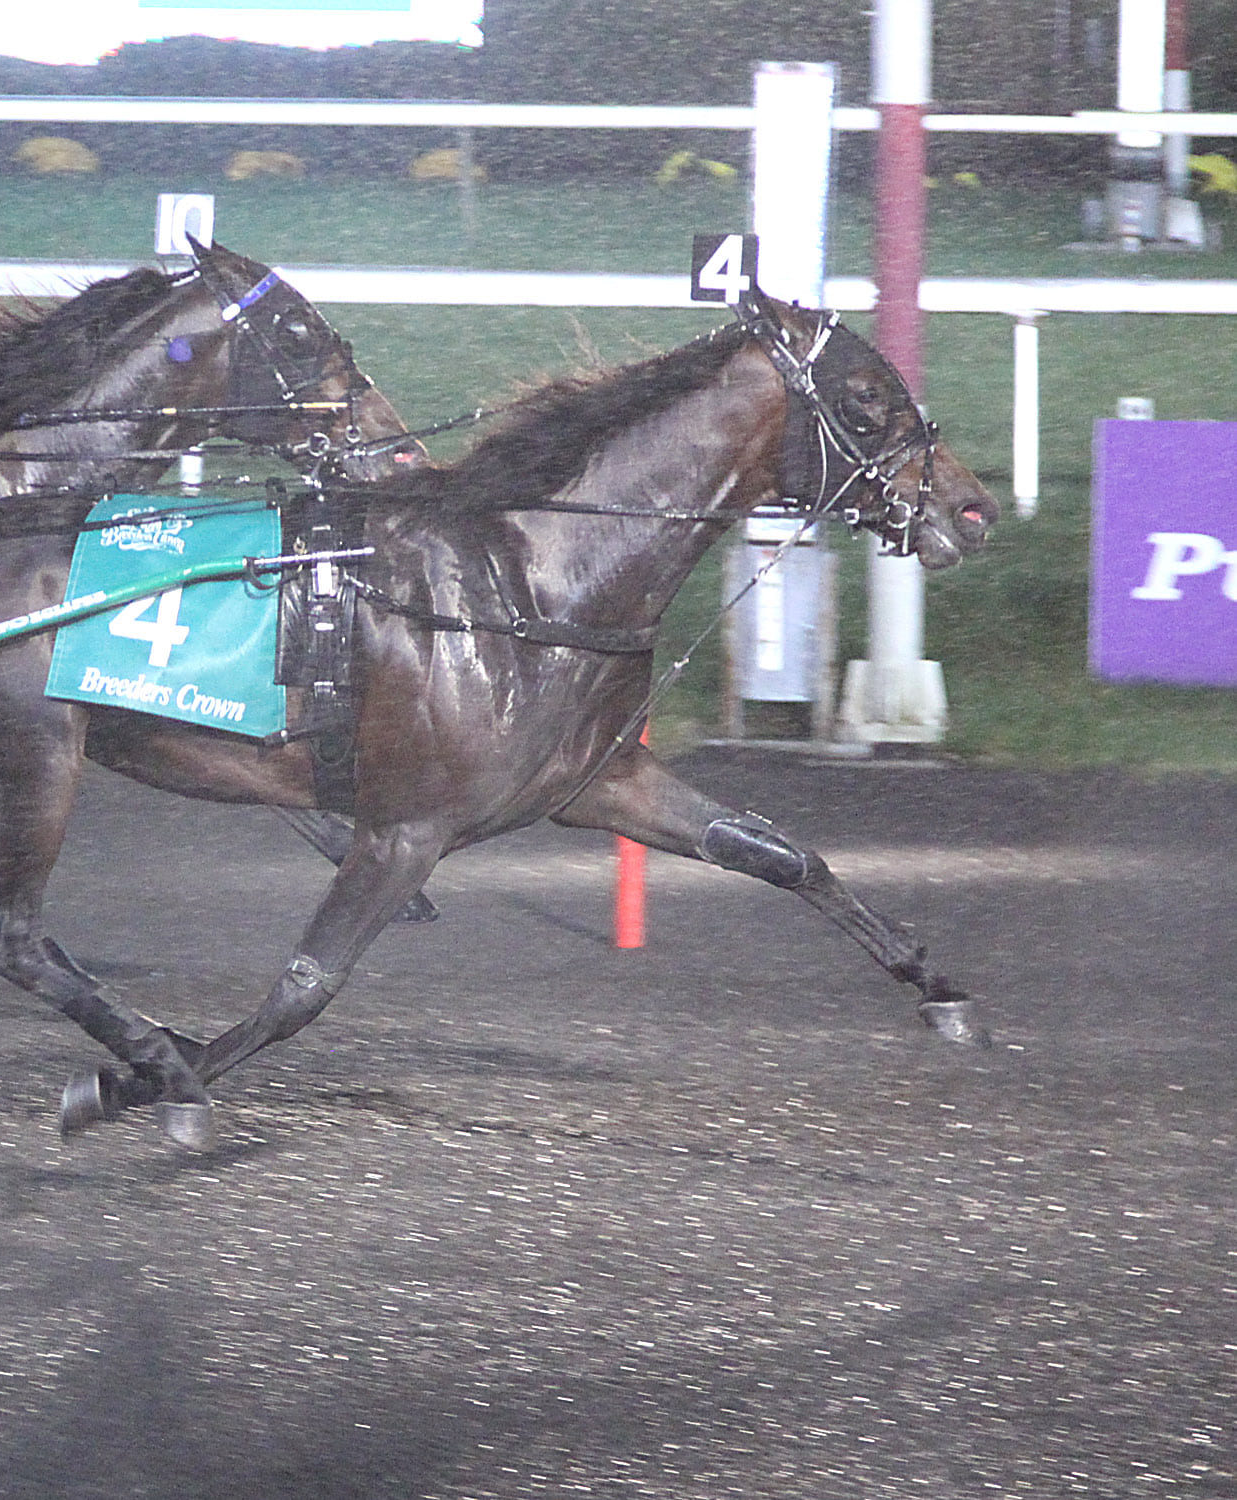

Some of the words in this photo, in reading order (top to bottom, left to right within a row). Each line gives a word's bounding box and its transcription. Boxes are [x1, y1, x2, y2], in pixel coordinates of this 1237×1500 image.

[699, 234, 750, 304] 4
[108, 588, 190, 668] 4
[78, 666, 173, 706] Breeders
[176, 683, 246, 722] Crown
